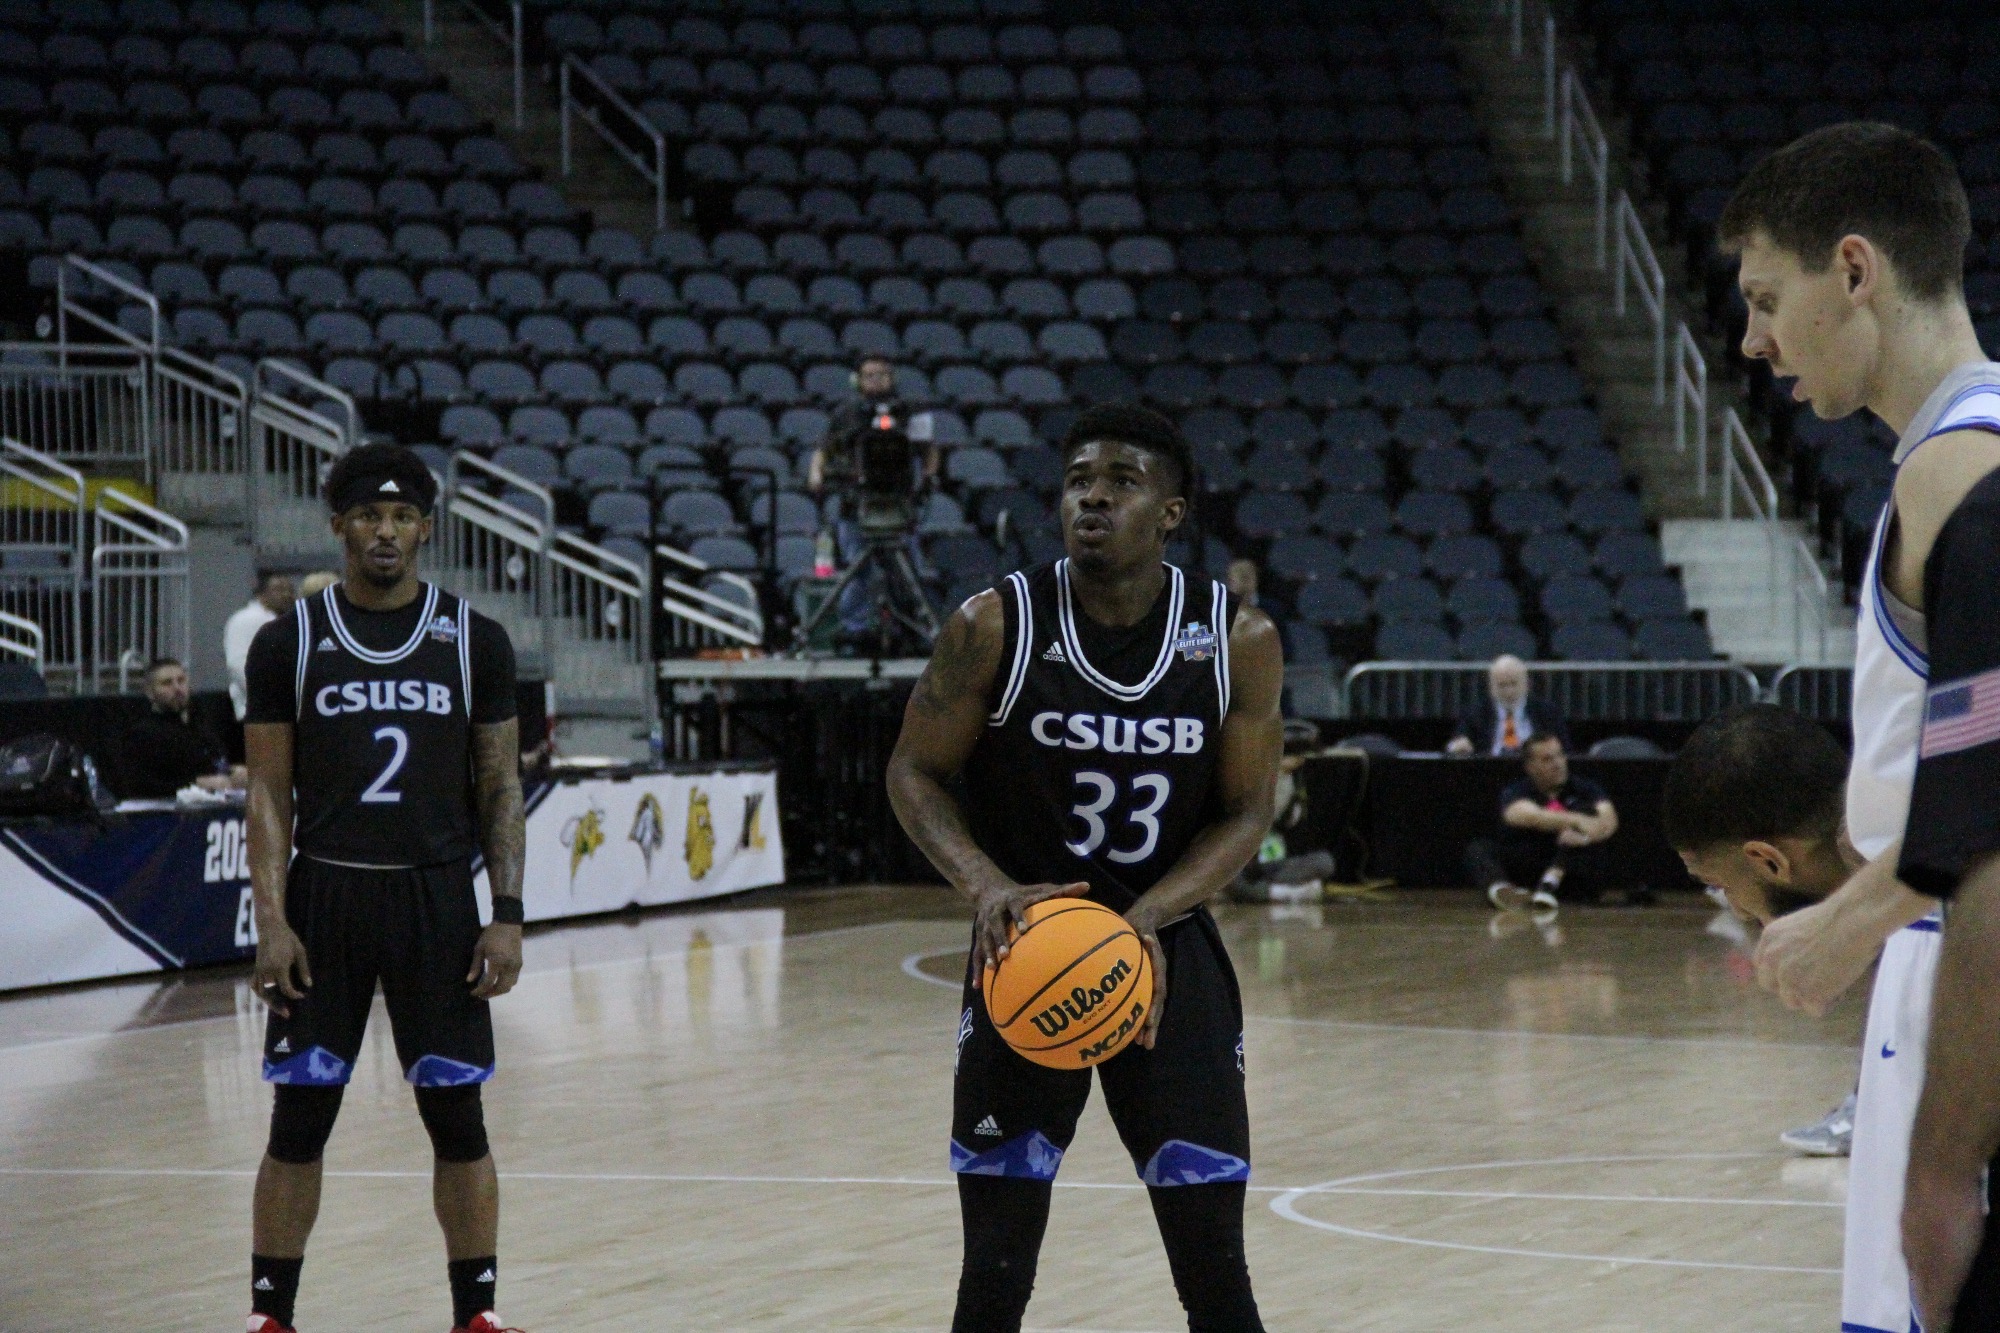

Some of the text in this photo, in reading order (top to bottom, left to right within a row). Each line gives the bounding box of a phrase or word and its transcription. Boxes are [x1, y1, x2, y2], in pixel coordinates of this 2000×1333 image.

[1179, 636, 1215, 648] ELITE EIGHT
[315, 680, 452, 717] CSUSB
[1030, 711, 1204, 755] CSUSB
[360, 726, 408, 803] 2
[1065, 771, 1171, 864] 33
[204, 820, 251, 882] 202
[1030, 958, 1132, 1038] Wilson
[1083, 1011, 1097, 1025] EVO
[1078, 1002, 1145, 1062] NCAA
[974, 1127, 1003, 1136] adidas
